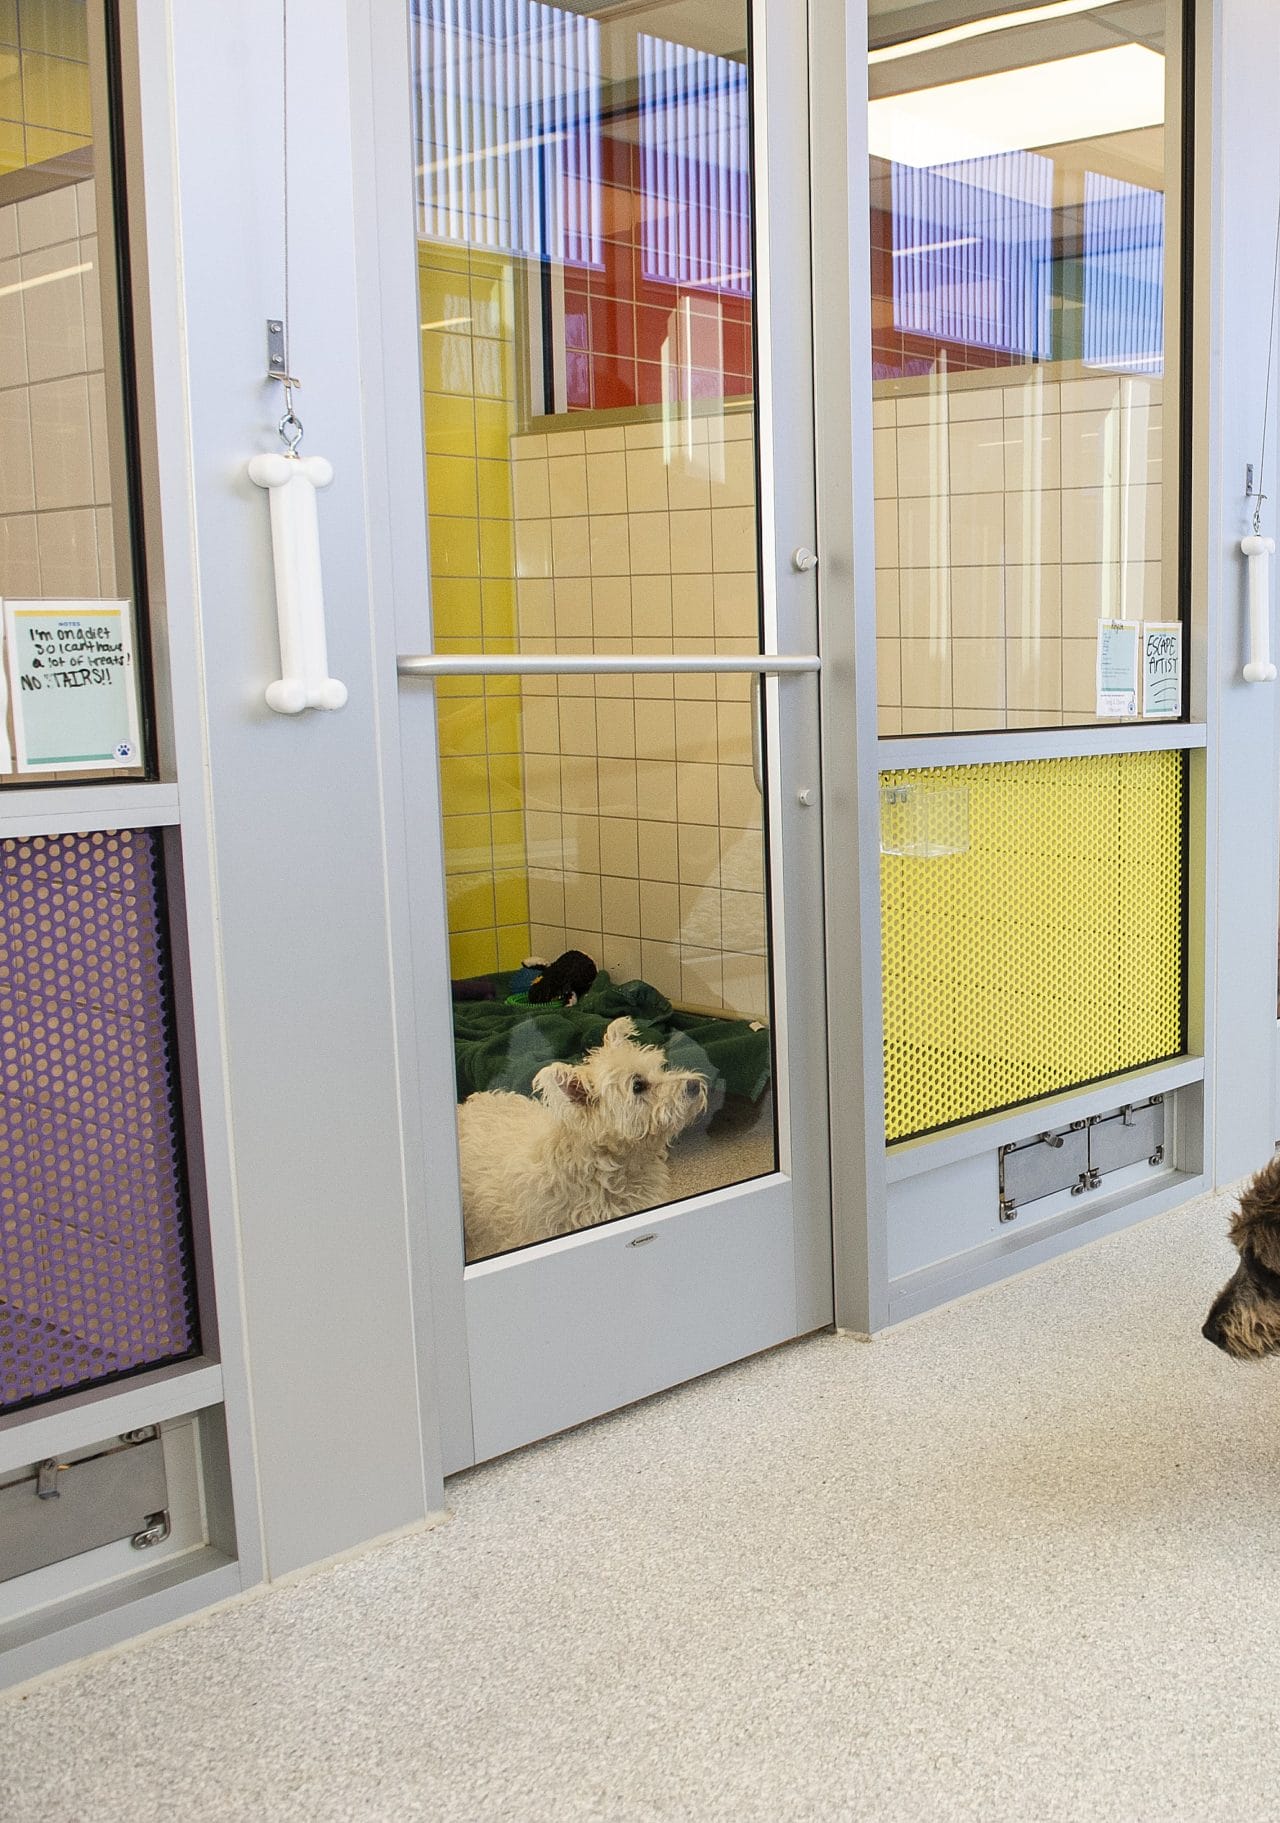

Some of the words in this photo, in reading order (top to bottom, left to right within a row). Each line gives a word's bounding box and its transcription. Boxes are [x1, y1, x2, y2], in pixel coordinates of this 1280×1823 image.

[29, 628, 54, 641] I'm
[86, 627, 111, 640] diet
[96, 641, 122, 652] have
[1146, 634, 1177, 657] ESCAPE
[32, 657, 45, 668] a
[48, 656, 65, 668] lot
